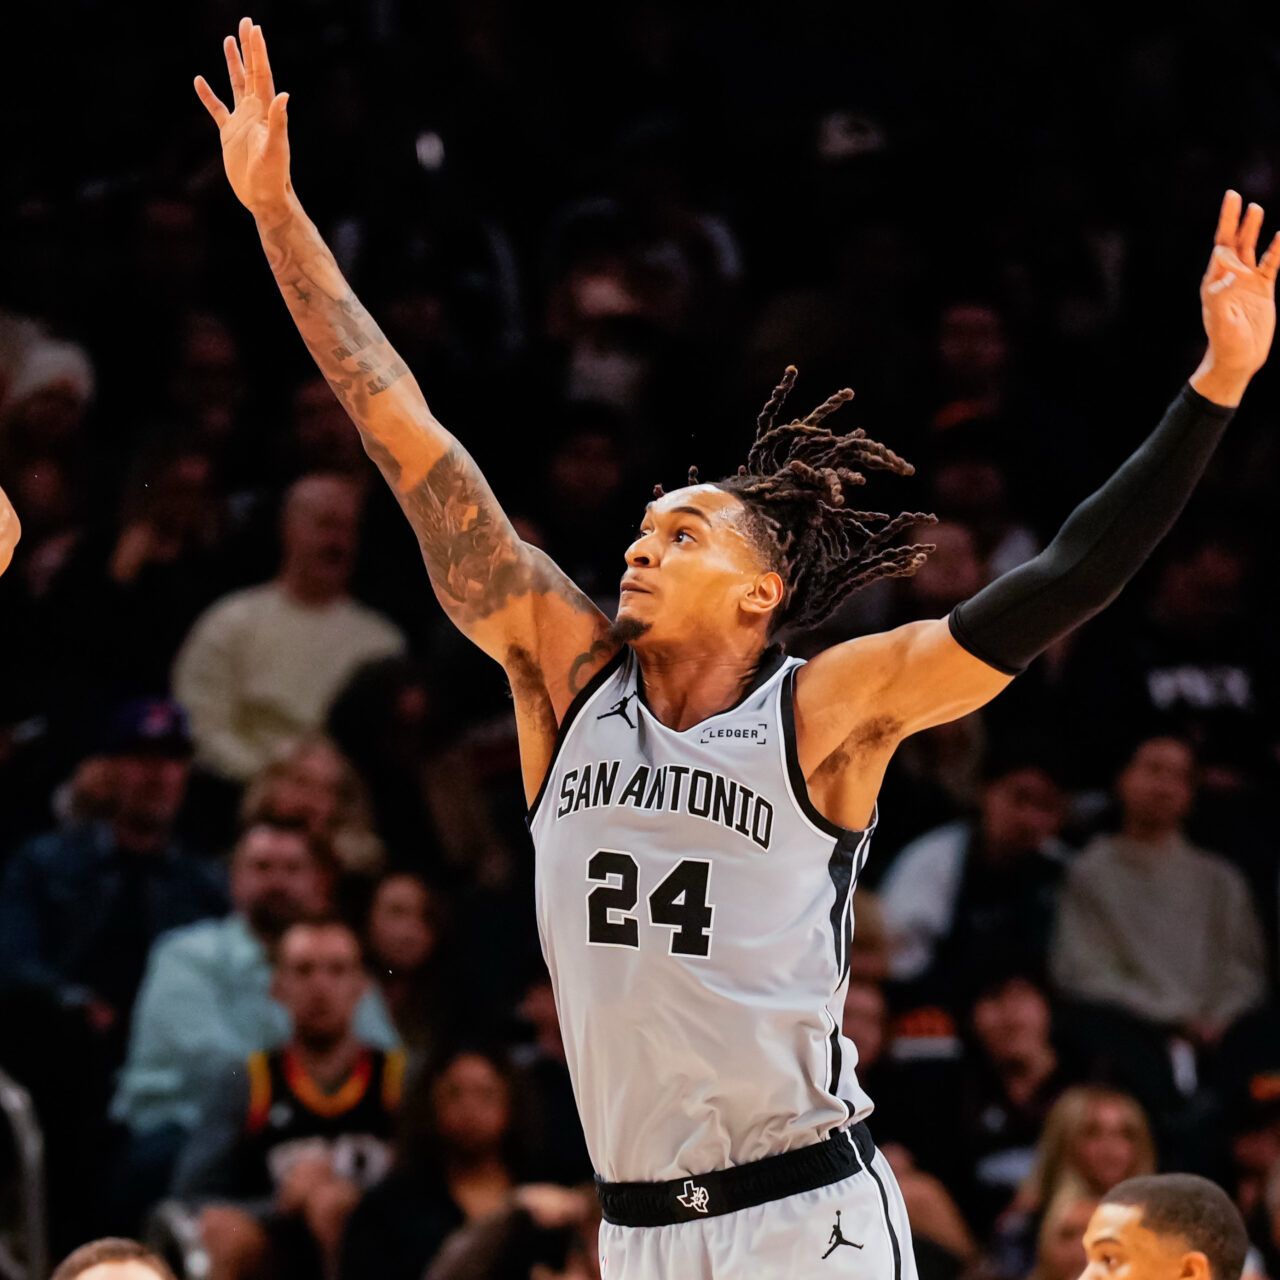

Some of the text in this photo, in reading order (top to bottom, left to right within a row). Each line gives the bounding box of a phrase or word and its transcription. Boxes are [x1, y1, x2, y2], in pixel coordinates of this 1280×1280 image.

[709, 728, 759, 739] LEDGER
[557, 760, 774, 852] SAN ANTONIO
[586, 848, 716, 960] 24
